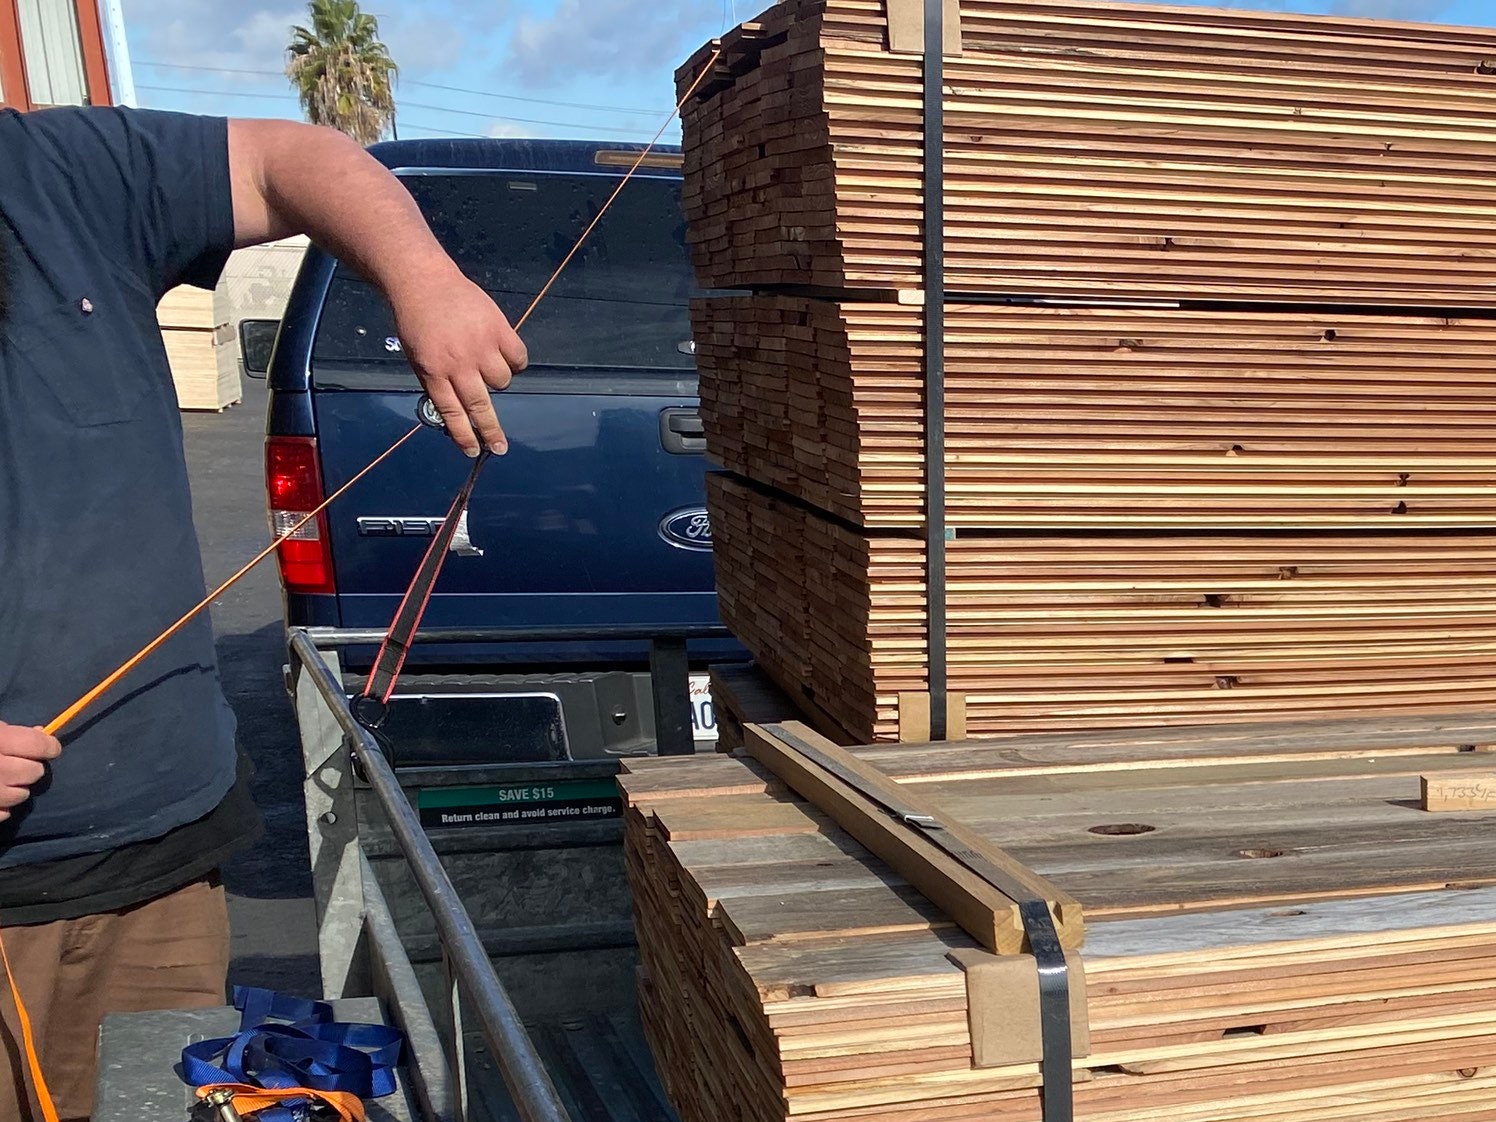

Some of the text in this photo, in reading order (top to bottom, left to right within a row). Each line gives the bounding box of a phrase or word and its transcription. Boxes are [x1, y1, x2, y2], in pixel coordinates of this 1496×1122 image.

[499, 787, 554, 801] SAVE $15
[441, 805, 616, 823] Return clean and avoid service charge.
